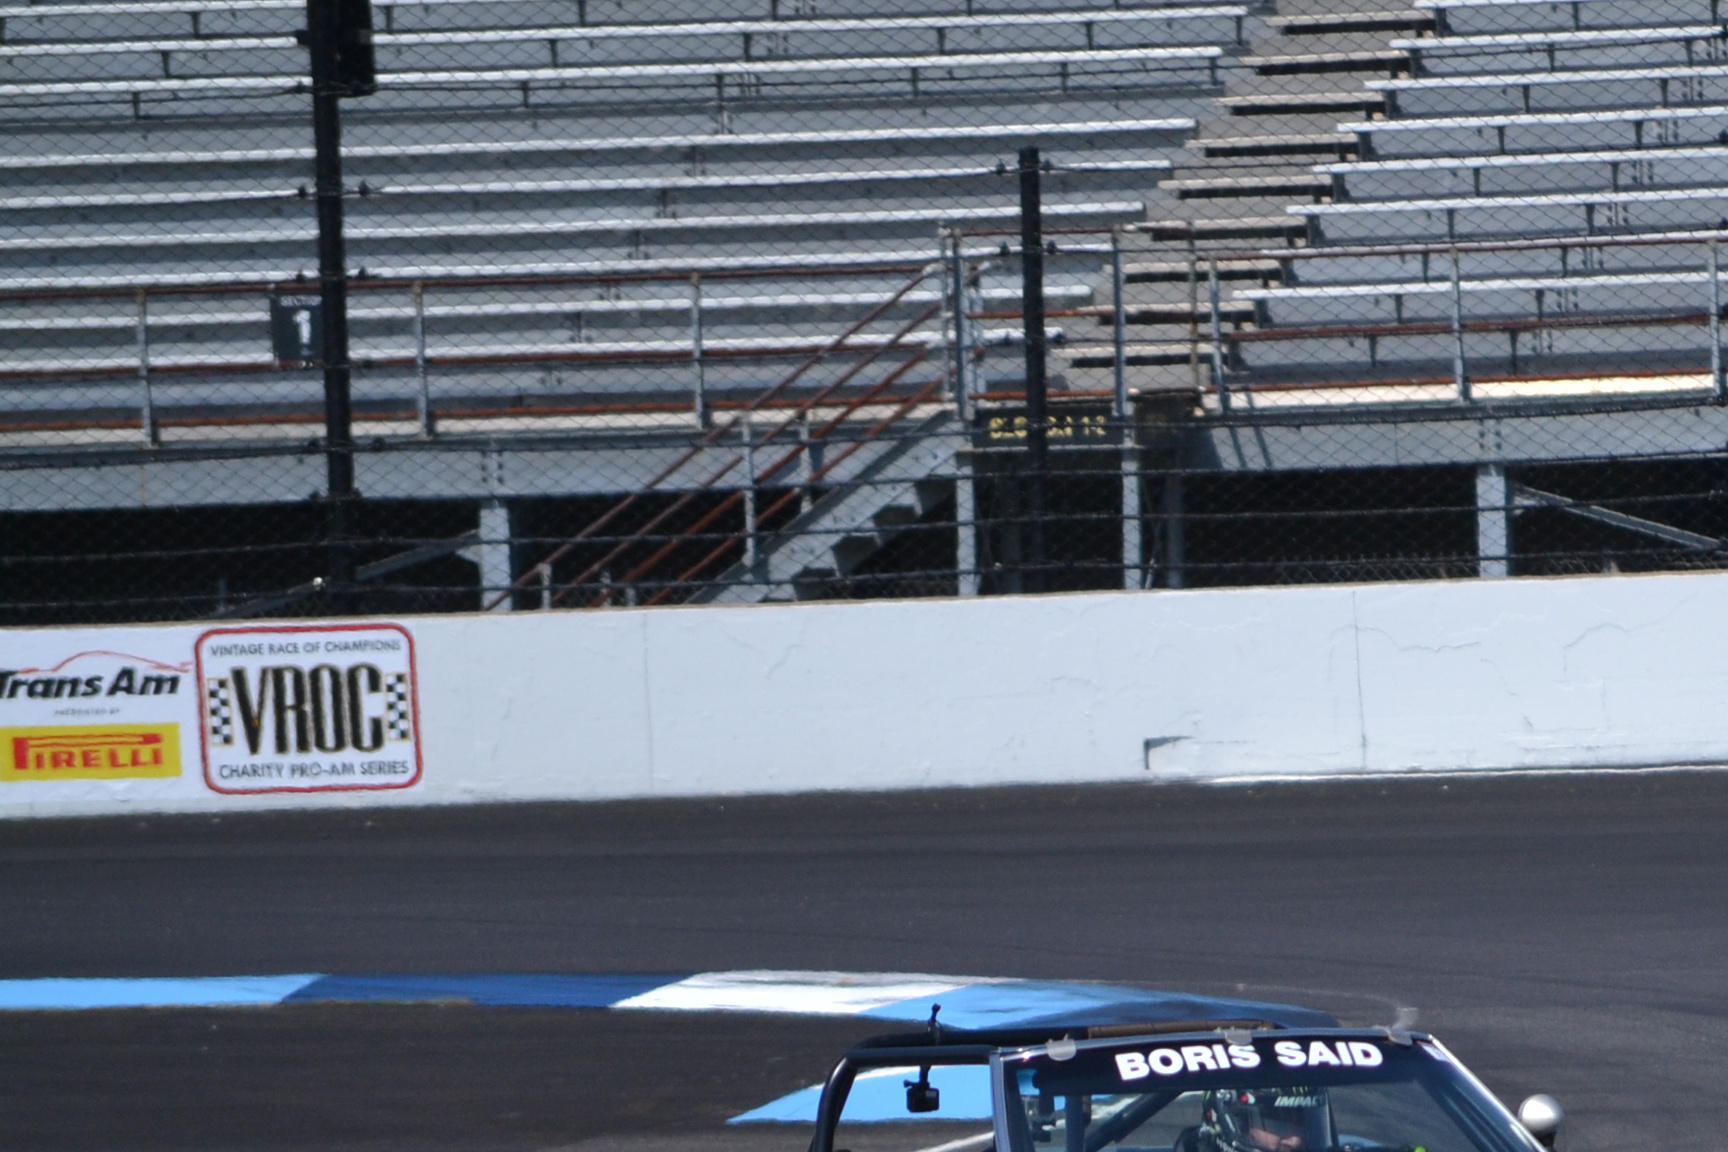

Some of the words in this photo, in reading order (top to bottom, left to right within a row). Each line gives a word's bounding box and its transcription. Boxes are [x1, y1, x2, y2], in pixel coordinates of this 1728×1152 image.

[210, 643, 264, 656] VINTAGE
[268, 642, 299, 654] RACE
[303, 641, 320, 653] OF
[324, 639, 401, 652] CHAMPIONS
[105, 667, 181, 696] Am
[230, 663, 385, 756] VROC
[13, 733, 163, 770] PIRELLI
[219, 763, 285, 779] CHARITY
[290, 762, 356, 777] PRO-AM
[360, 760, 409, 775] SERIES
[1115, 1044, 1261, 1081] BORIS
[1274, 1041, 1383, 1067] SAID
